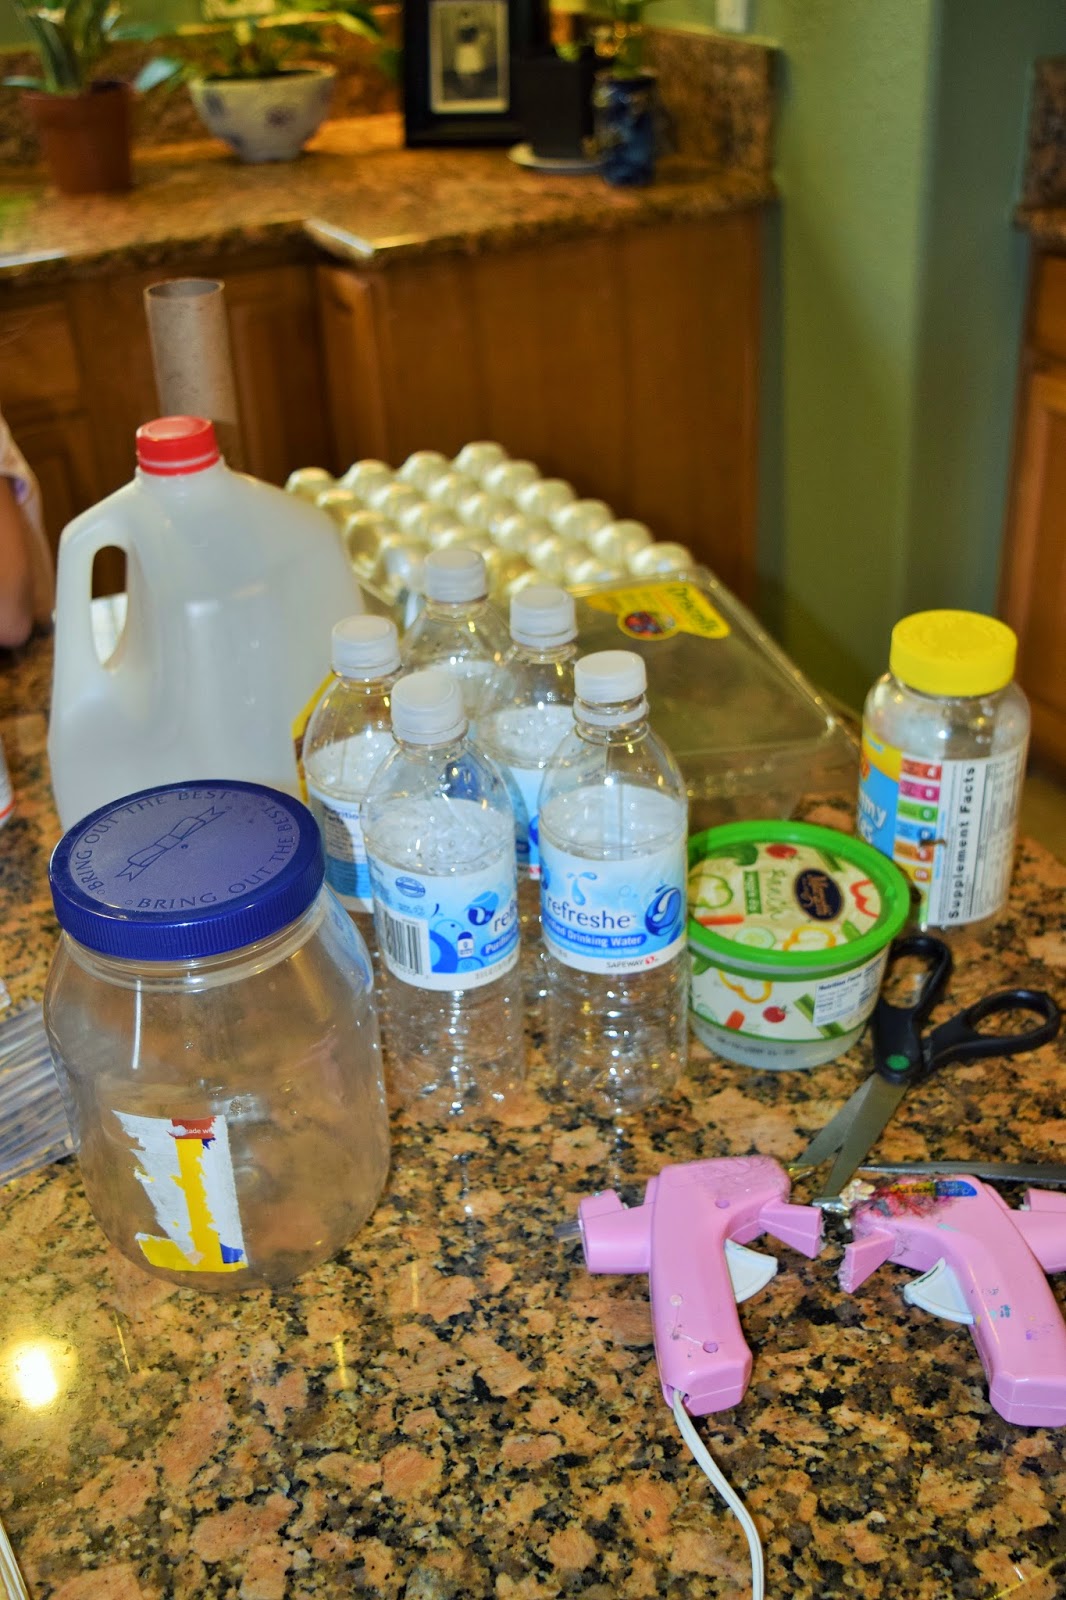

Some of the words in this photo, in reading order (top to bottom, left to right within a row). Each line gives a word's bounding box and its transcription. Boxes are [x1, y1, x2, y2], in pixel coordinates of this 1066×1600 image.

[122, 797, 168, 815] THE
[178, 790, 231, 801] BEST
[84, 816, 119, 844] OUT
[262, 806, 293, 832] BEST
[269, 836, 294, 862] THE
[949, 819, 970, 919] Supplement
[960, 767, 975, 814] Facts
[75, 850, 105, 892] BRING
[228, 866, 273, 894] OUT
[137, 892, 218, 909] BRING
[546, 897, 631, 930] refreshe
[567, 929, 609, 948] Drinking
[611, 935, 642, 947] Water
[606, 960, 644, 969] SAFEWAY
